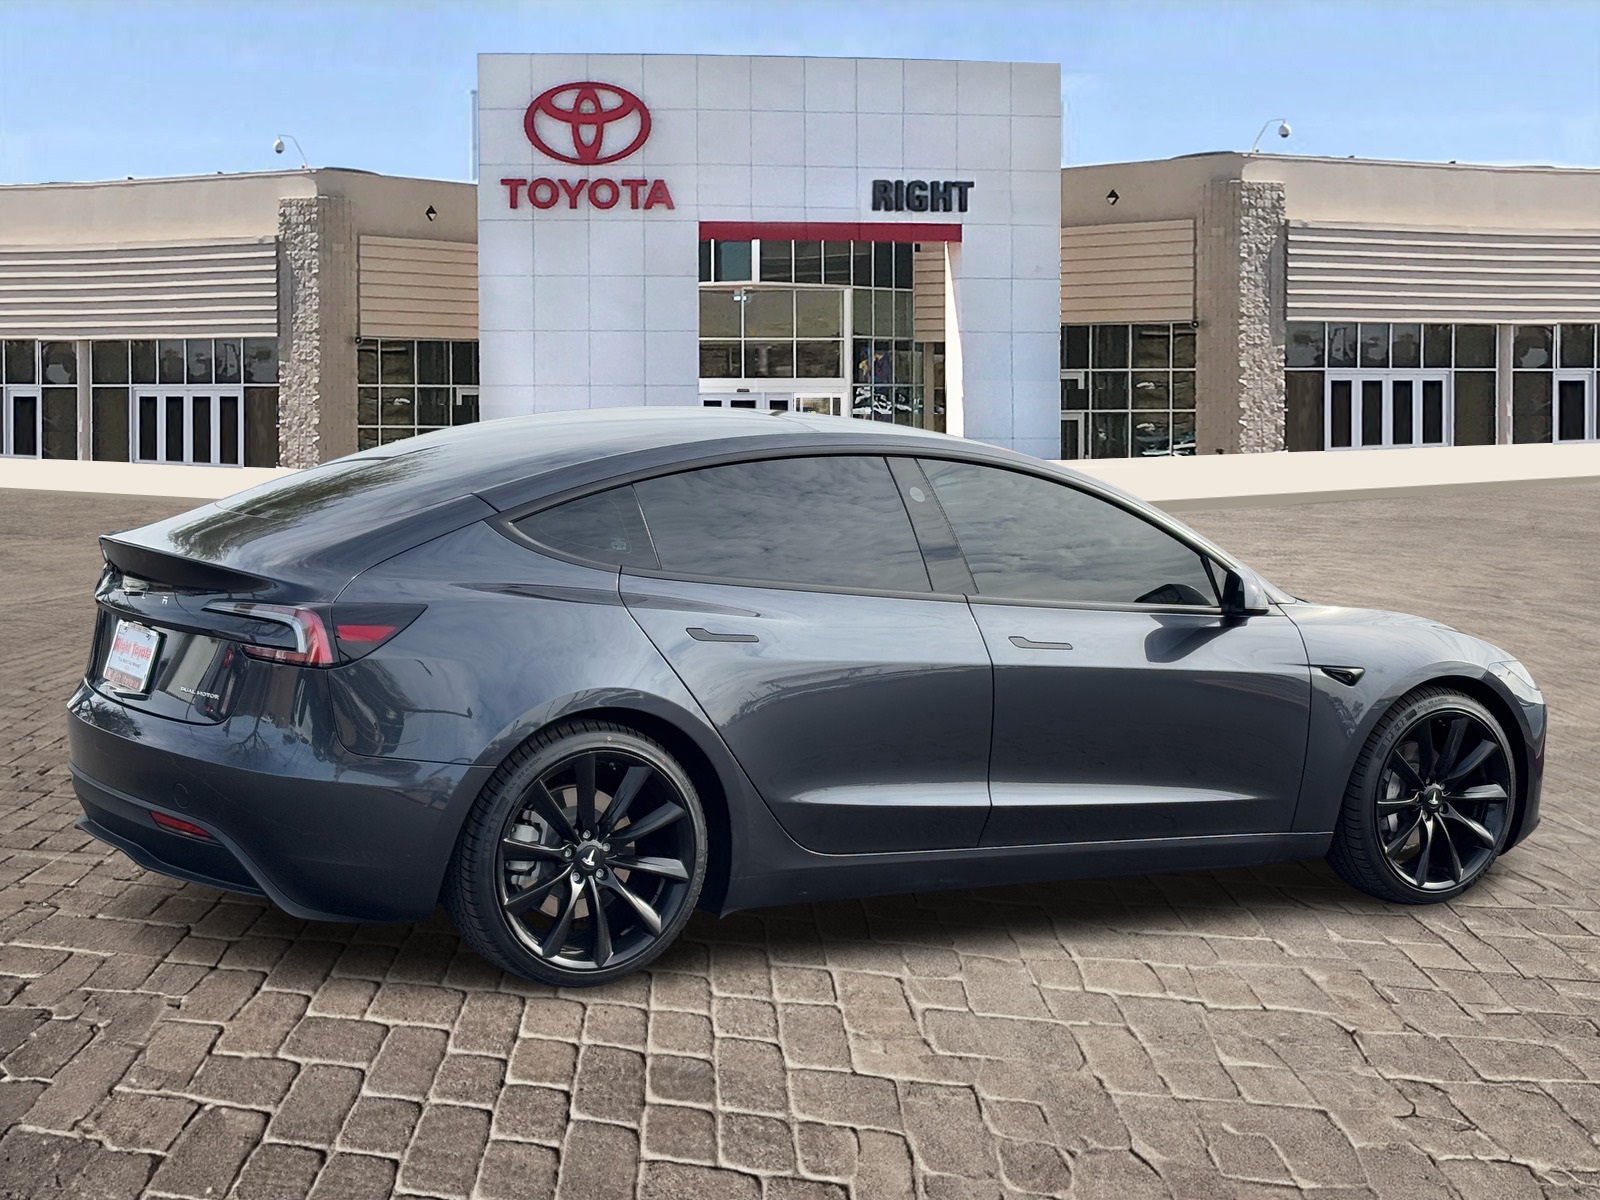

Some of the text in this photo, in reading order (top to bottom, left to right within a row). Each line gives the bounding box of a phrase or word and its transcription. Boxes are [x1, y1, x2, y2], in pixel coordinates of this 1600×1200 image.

[500, 177, 676, 210] TOYOTA
[871, 179, 975, 212] RIGHT
[132, 643, 153, 660] Toyota
[180, 686, 220, 700] DUAL MOTOR
